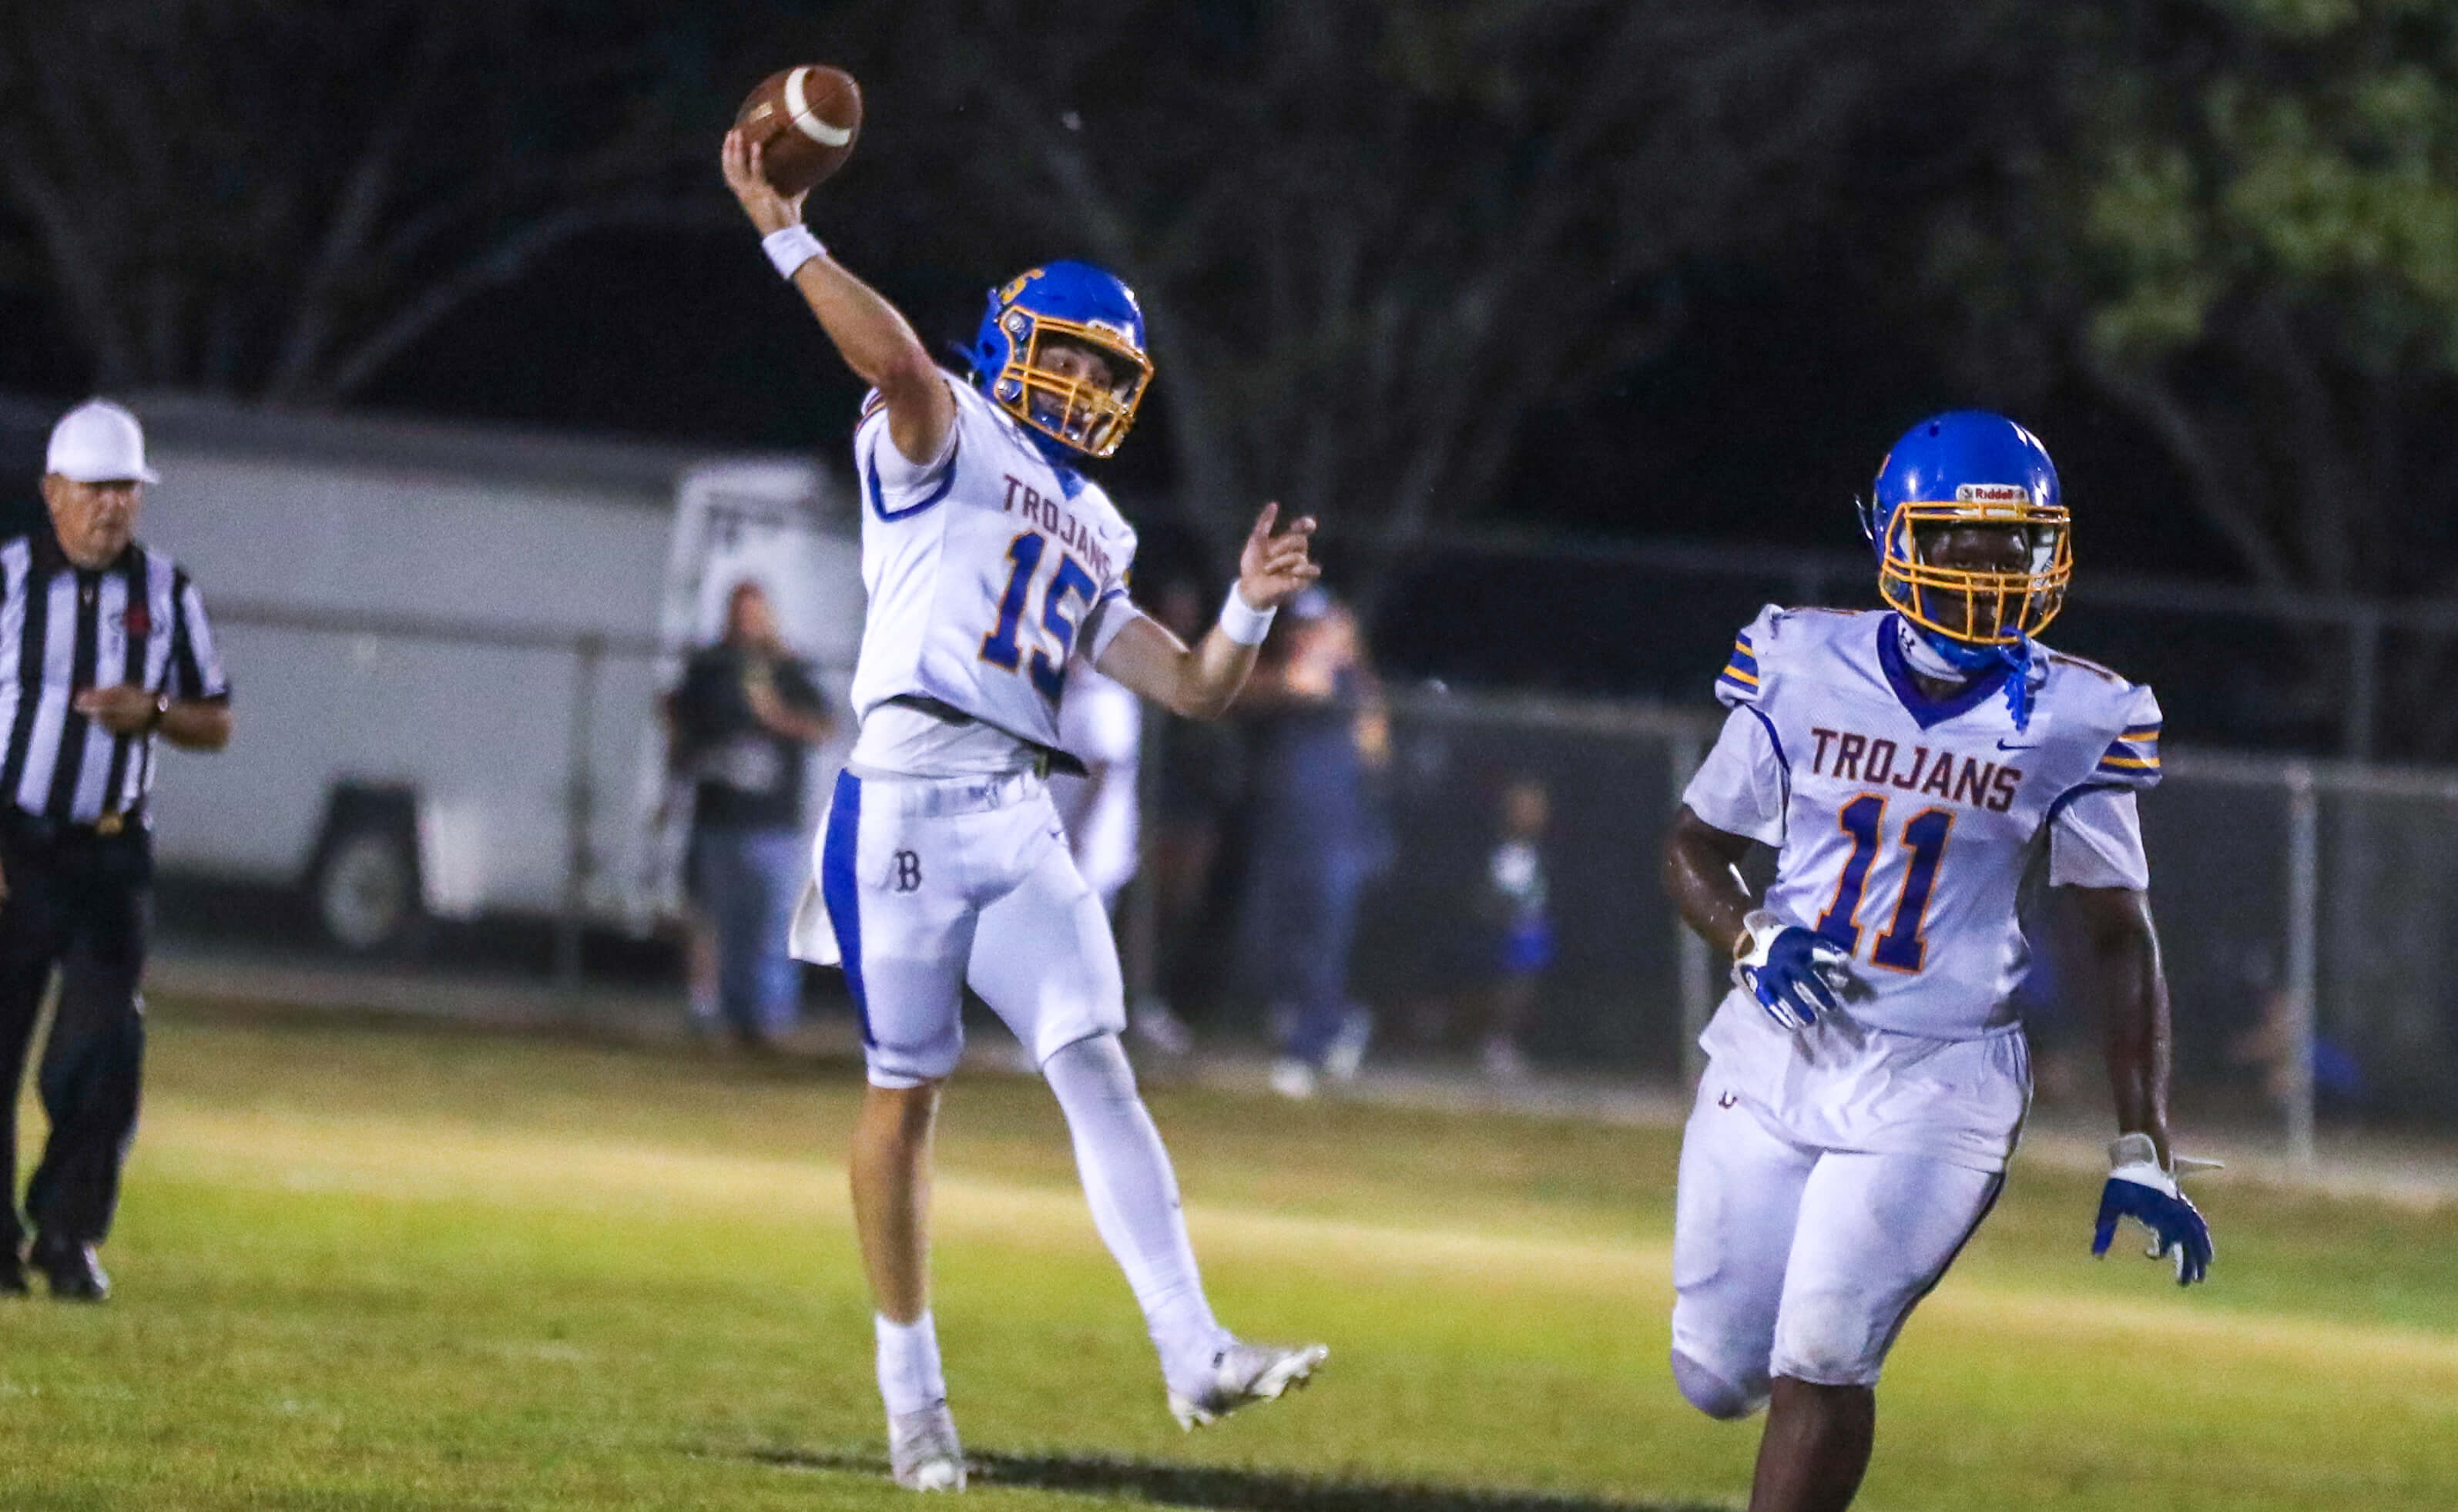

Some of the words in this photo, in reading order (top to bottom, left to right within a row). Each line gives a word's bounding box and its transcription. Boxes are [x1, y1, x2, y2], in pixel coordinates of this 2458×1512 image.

[977, 529, 1098, 706] 15
[1810, 726, 2023, 813] TROJANS
[893, 850, 923, 892] B
[1815, 791, 1957, 975] 11
